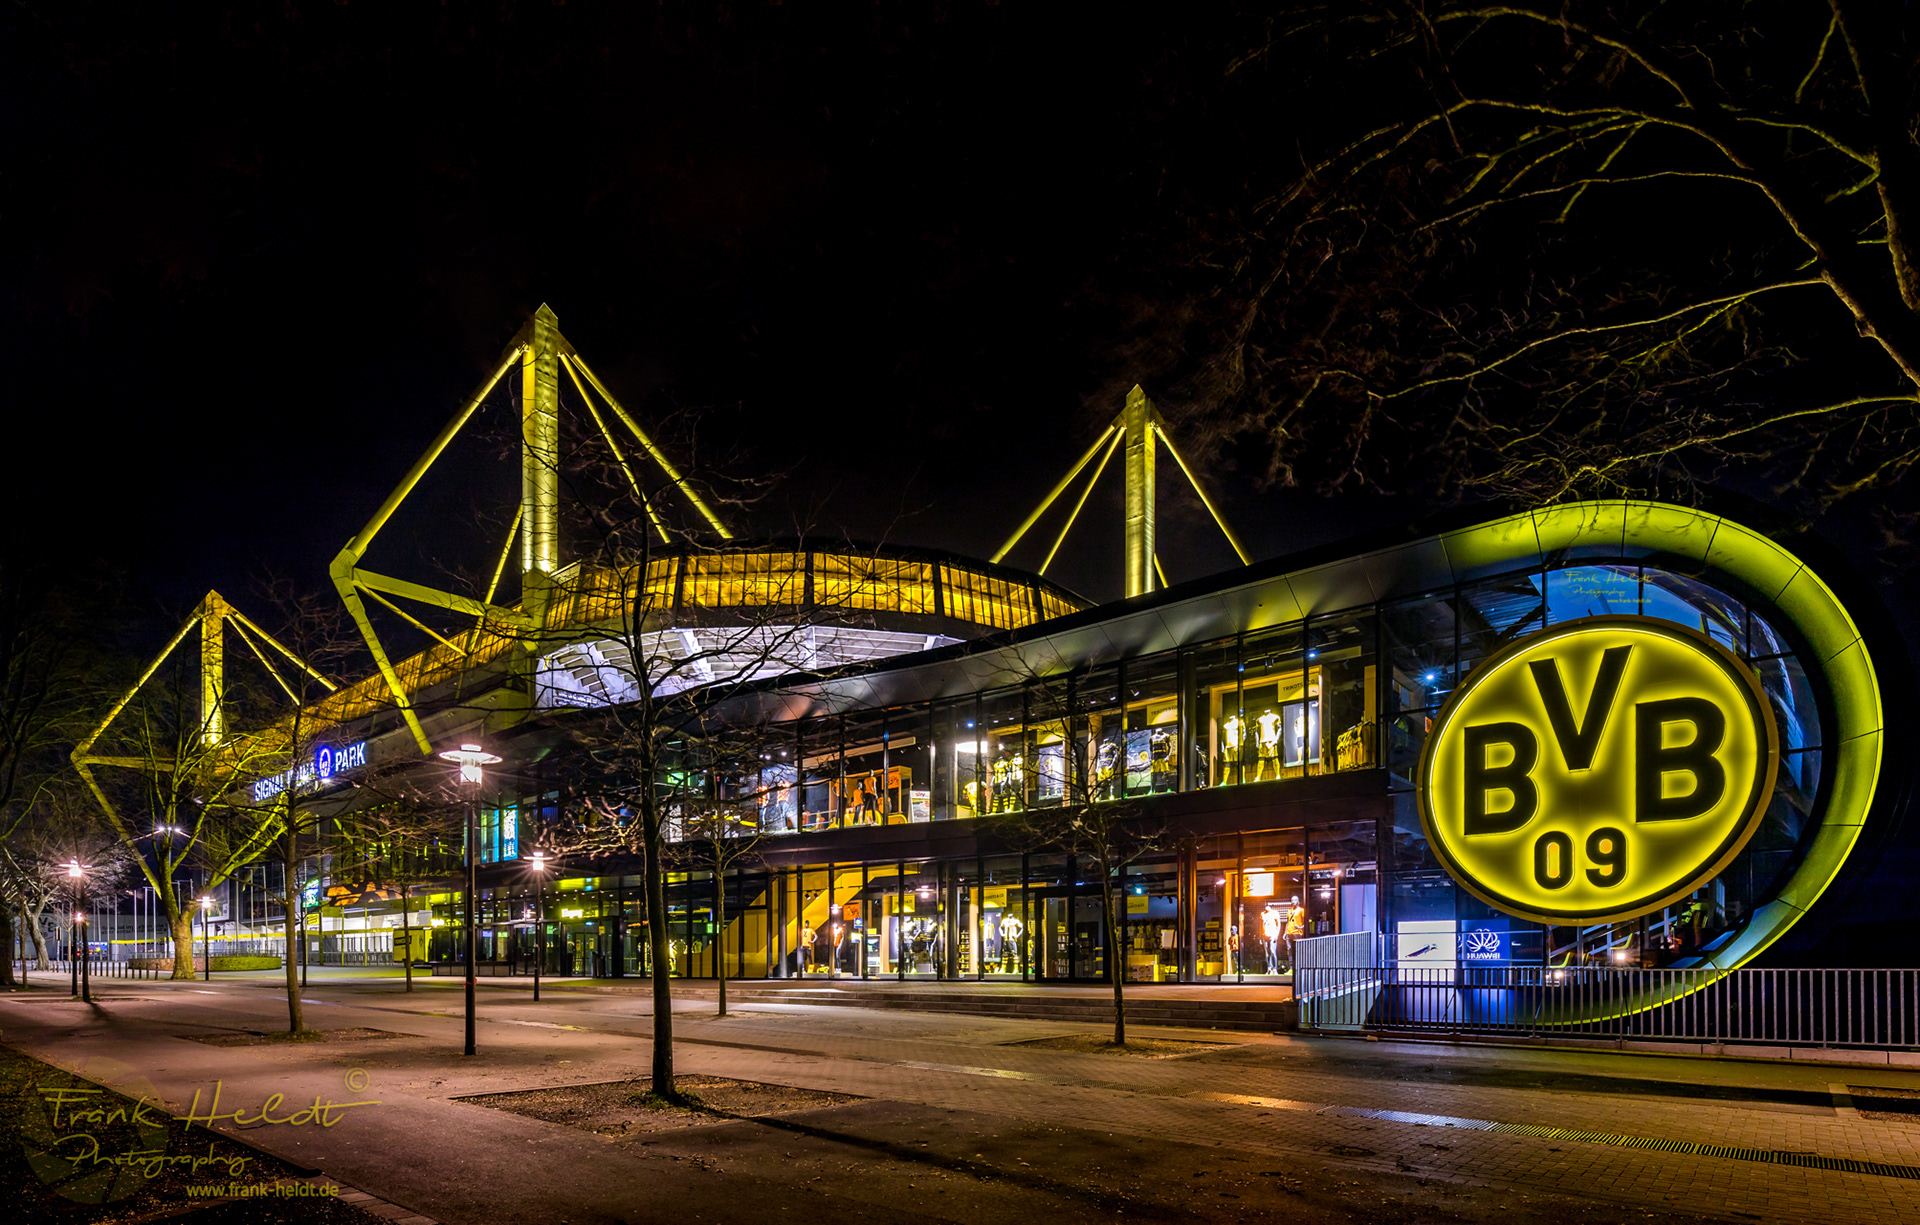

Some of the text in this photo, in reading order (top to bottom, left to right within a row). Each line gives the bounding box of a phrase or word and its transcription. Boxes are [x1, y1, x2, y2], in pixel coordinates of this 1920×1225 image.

[335, 742, 366, 772] PARK
[1464, 644, 1726, 838] BVB
[1534, 827, 1628, 890] 09
[1467, 952, 1500, 960] HUAWEI
